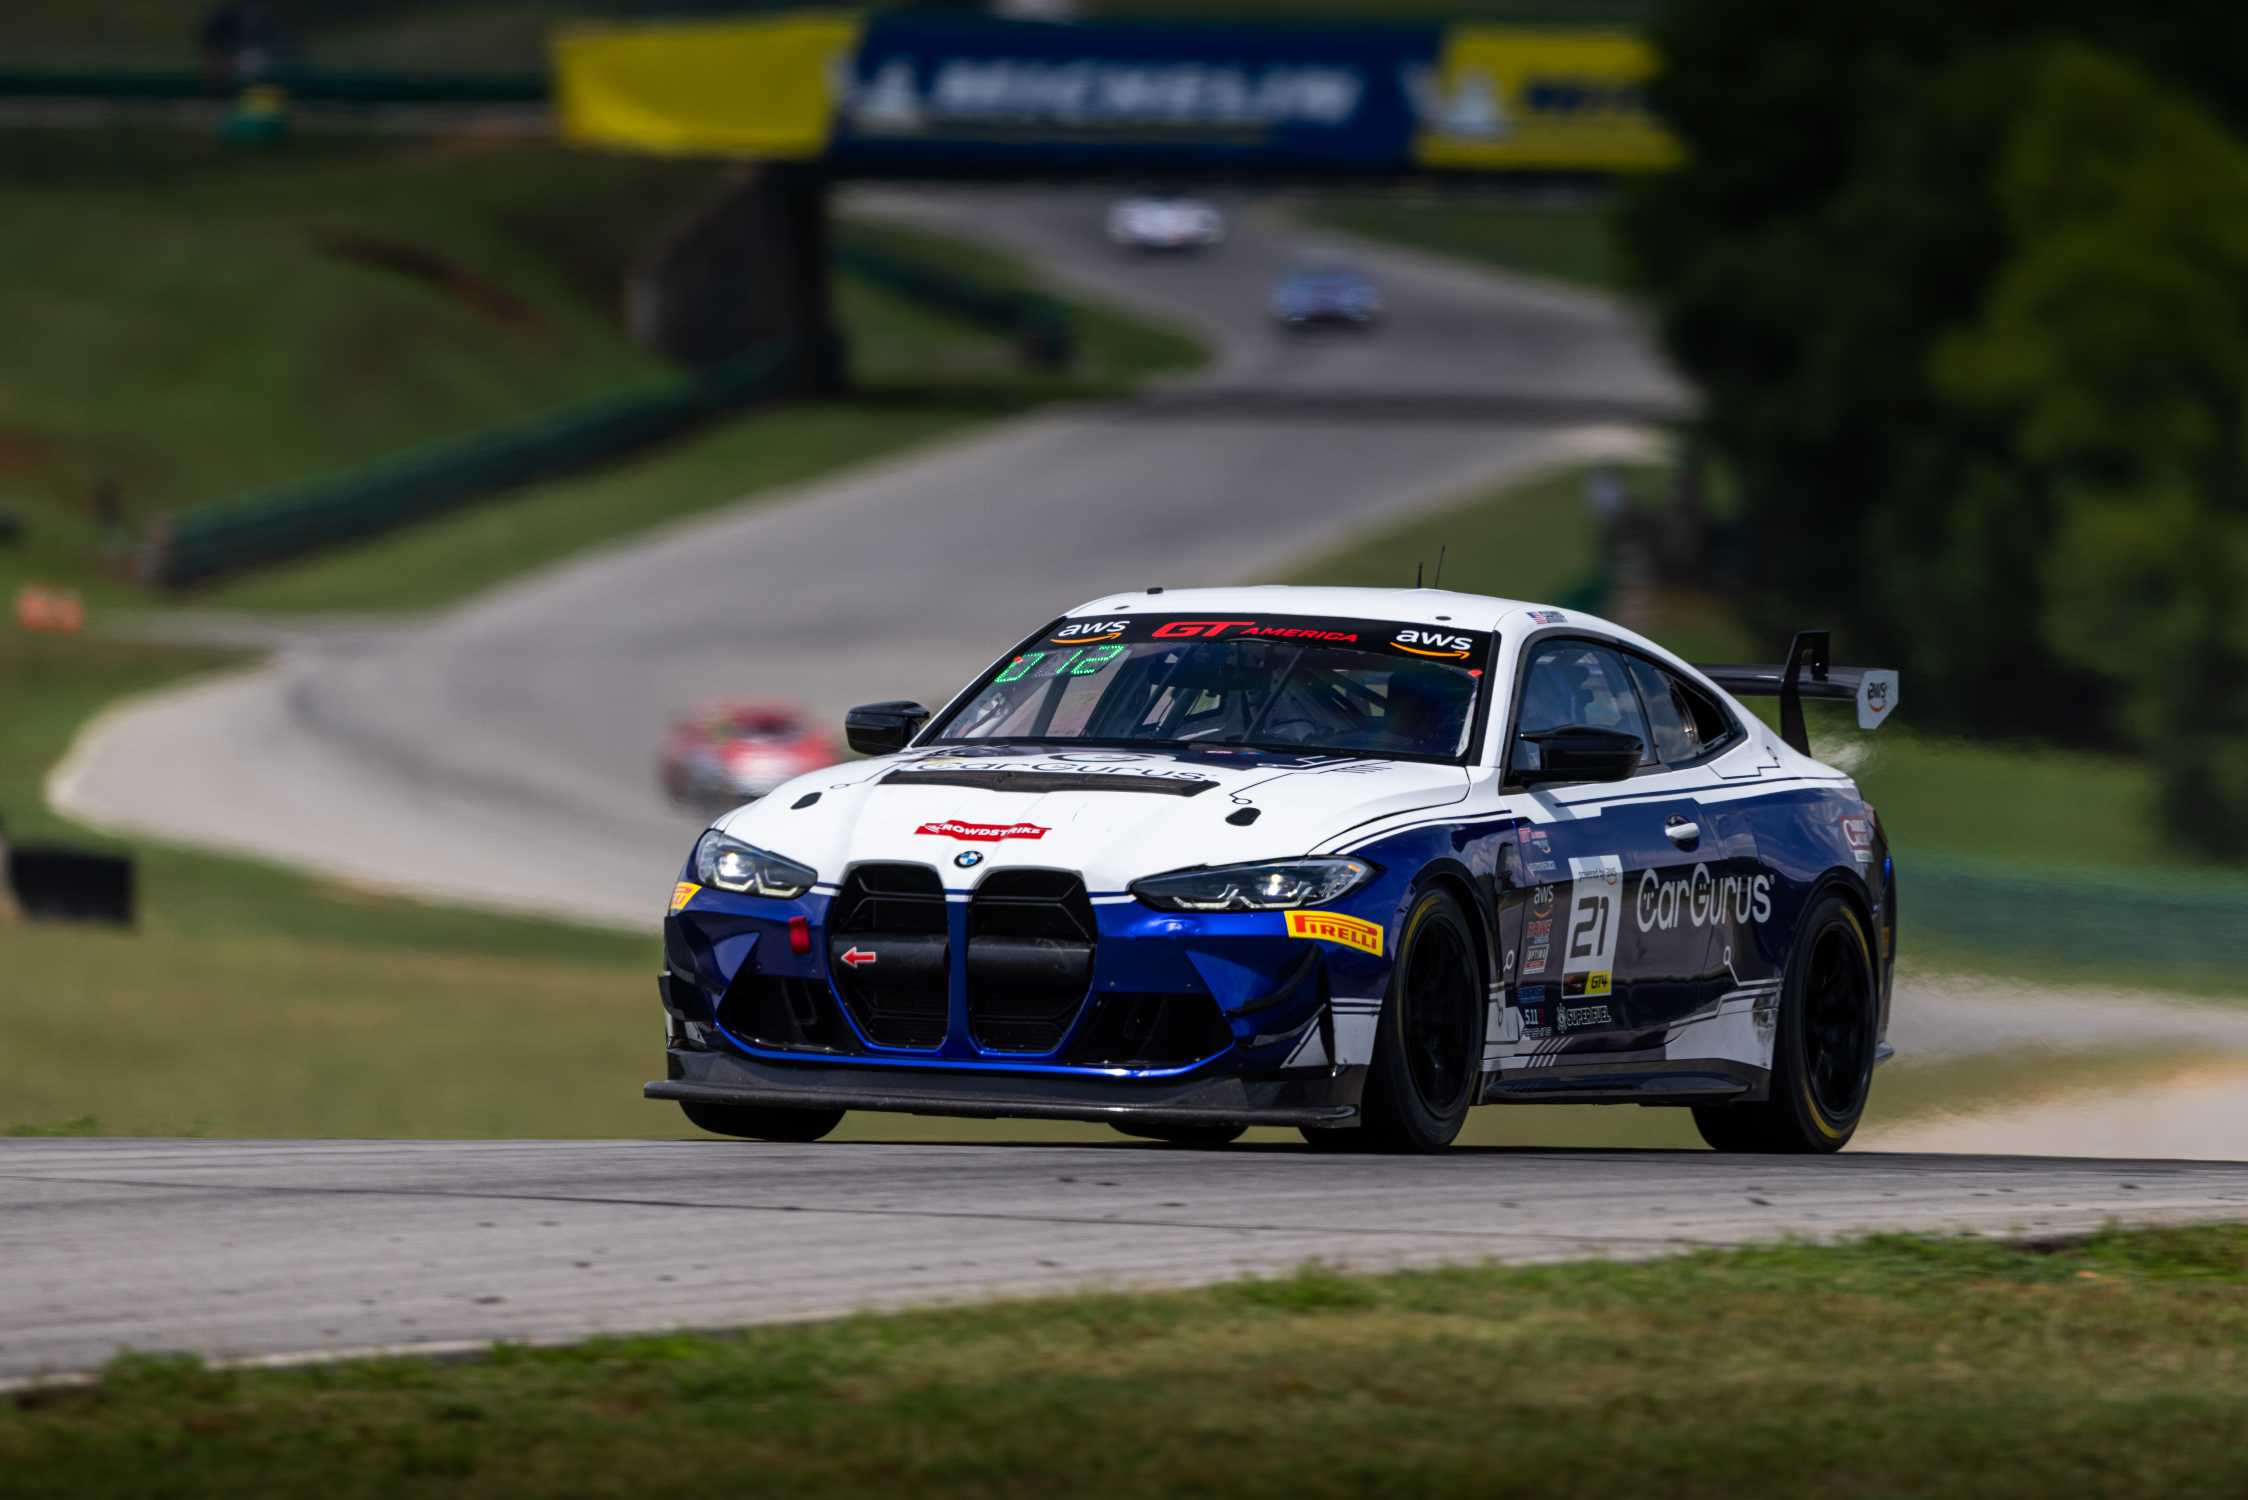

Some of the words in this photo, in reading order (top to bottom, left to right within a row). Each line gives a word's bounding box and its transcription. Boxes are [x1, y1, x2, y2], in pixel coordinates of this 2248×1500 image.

[1058, 620, 1130, 637] aws
[1240, 627, 1359, 643] AMERICA
[1396, 629, 1472, 651] aws
[1534, 884, 1554, 905] aws
[1636, 861, 1772, 933] CarGurus
[1293, 915, 1378, 950] PIRELLI
[1569, 895, 1609, 958] 21
[1591, 974, 1608, 990] GT4
